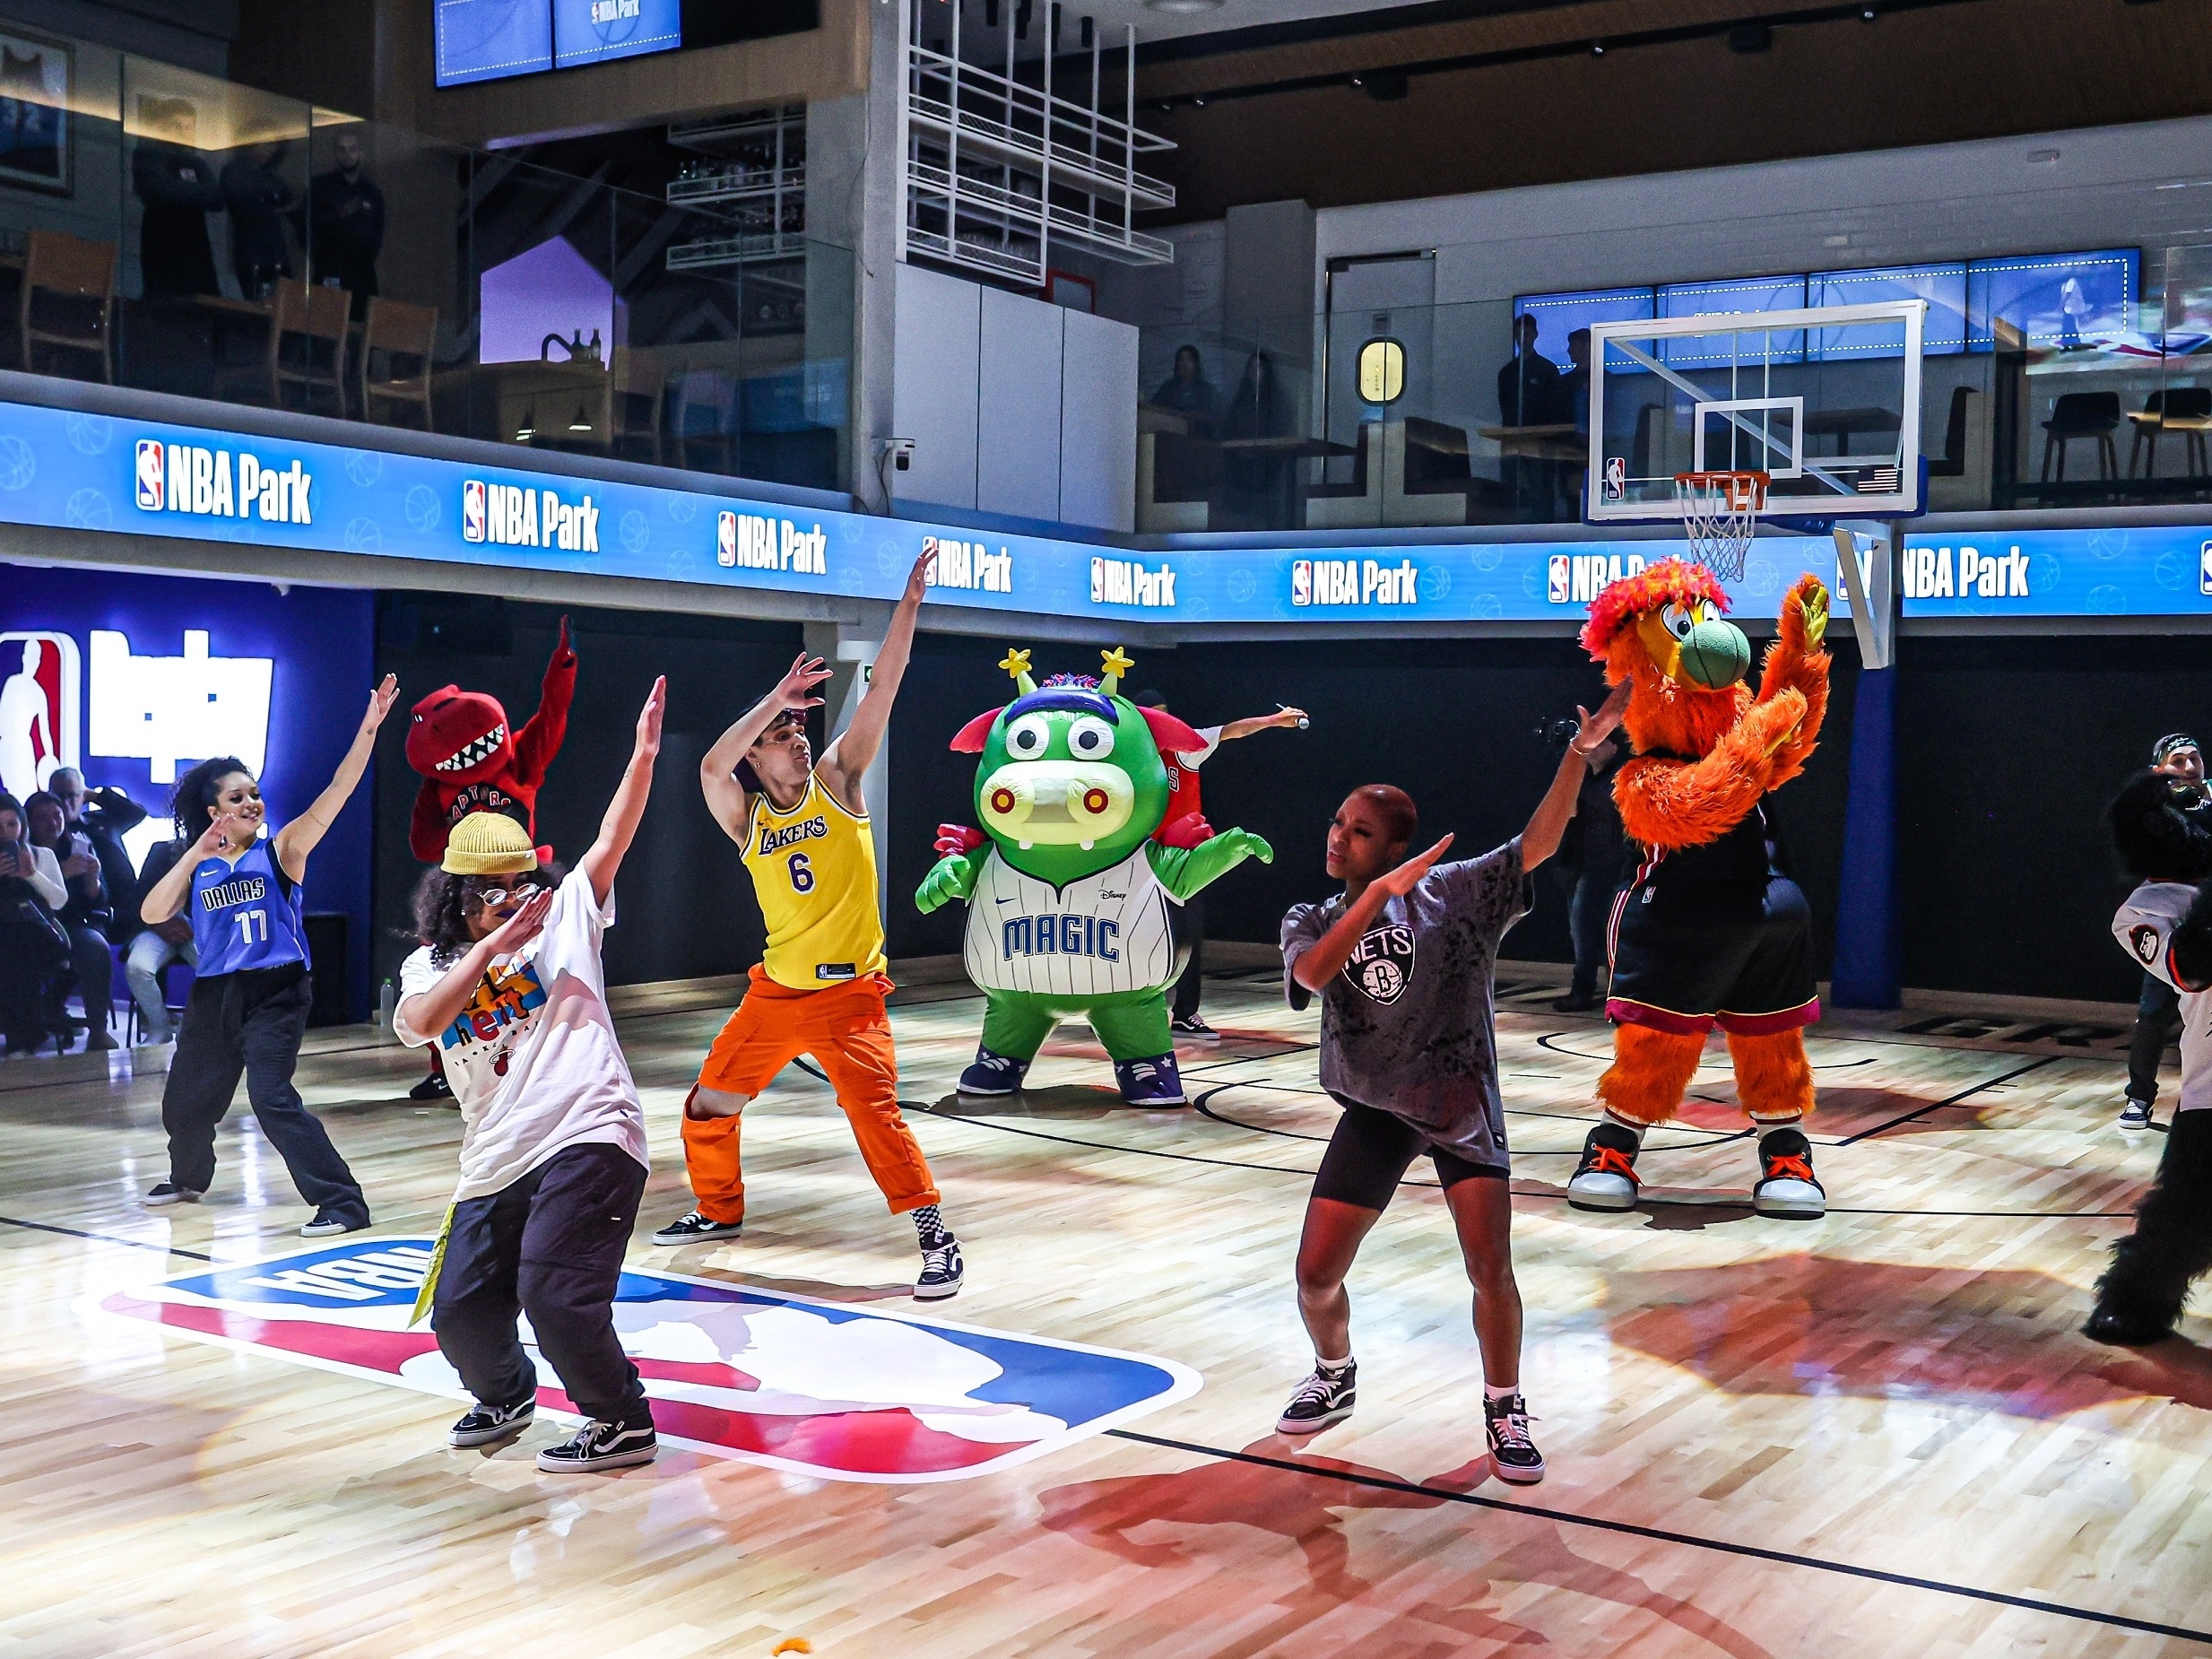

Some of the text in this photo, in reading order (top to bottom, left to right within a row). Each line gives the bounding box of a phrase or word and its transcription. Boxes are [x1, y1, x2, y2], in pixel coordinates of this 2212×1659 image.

[599, 0, 618, 22] NBA
[168, 445, 312, 525] NBA Park
[488, 483, 599, 553] NBA Park
[737, 515, 827, 575] NBA Park
[938, 539, 1012, 593] NBA Park
[1104, 560, 1176, 607] NBA Park
[1314, 559, 1418, 605] NBA Park
[1902, 545, 2030, 598] NBA Park
[447, 785, 511, 824] APTOR
[759, 815, 828, 855] LAKERS
[200, 877, 265, 912] DALLAS
[787, 852, 816, 895] 6
[1002, 914, 1119, 963] MAGIC
